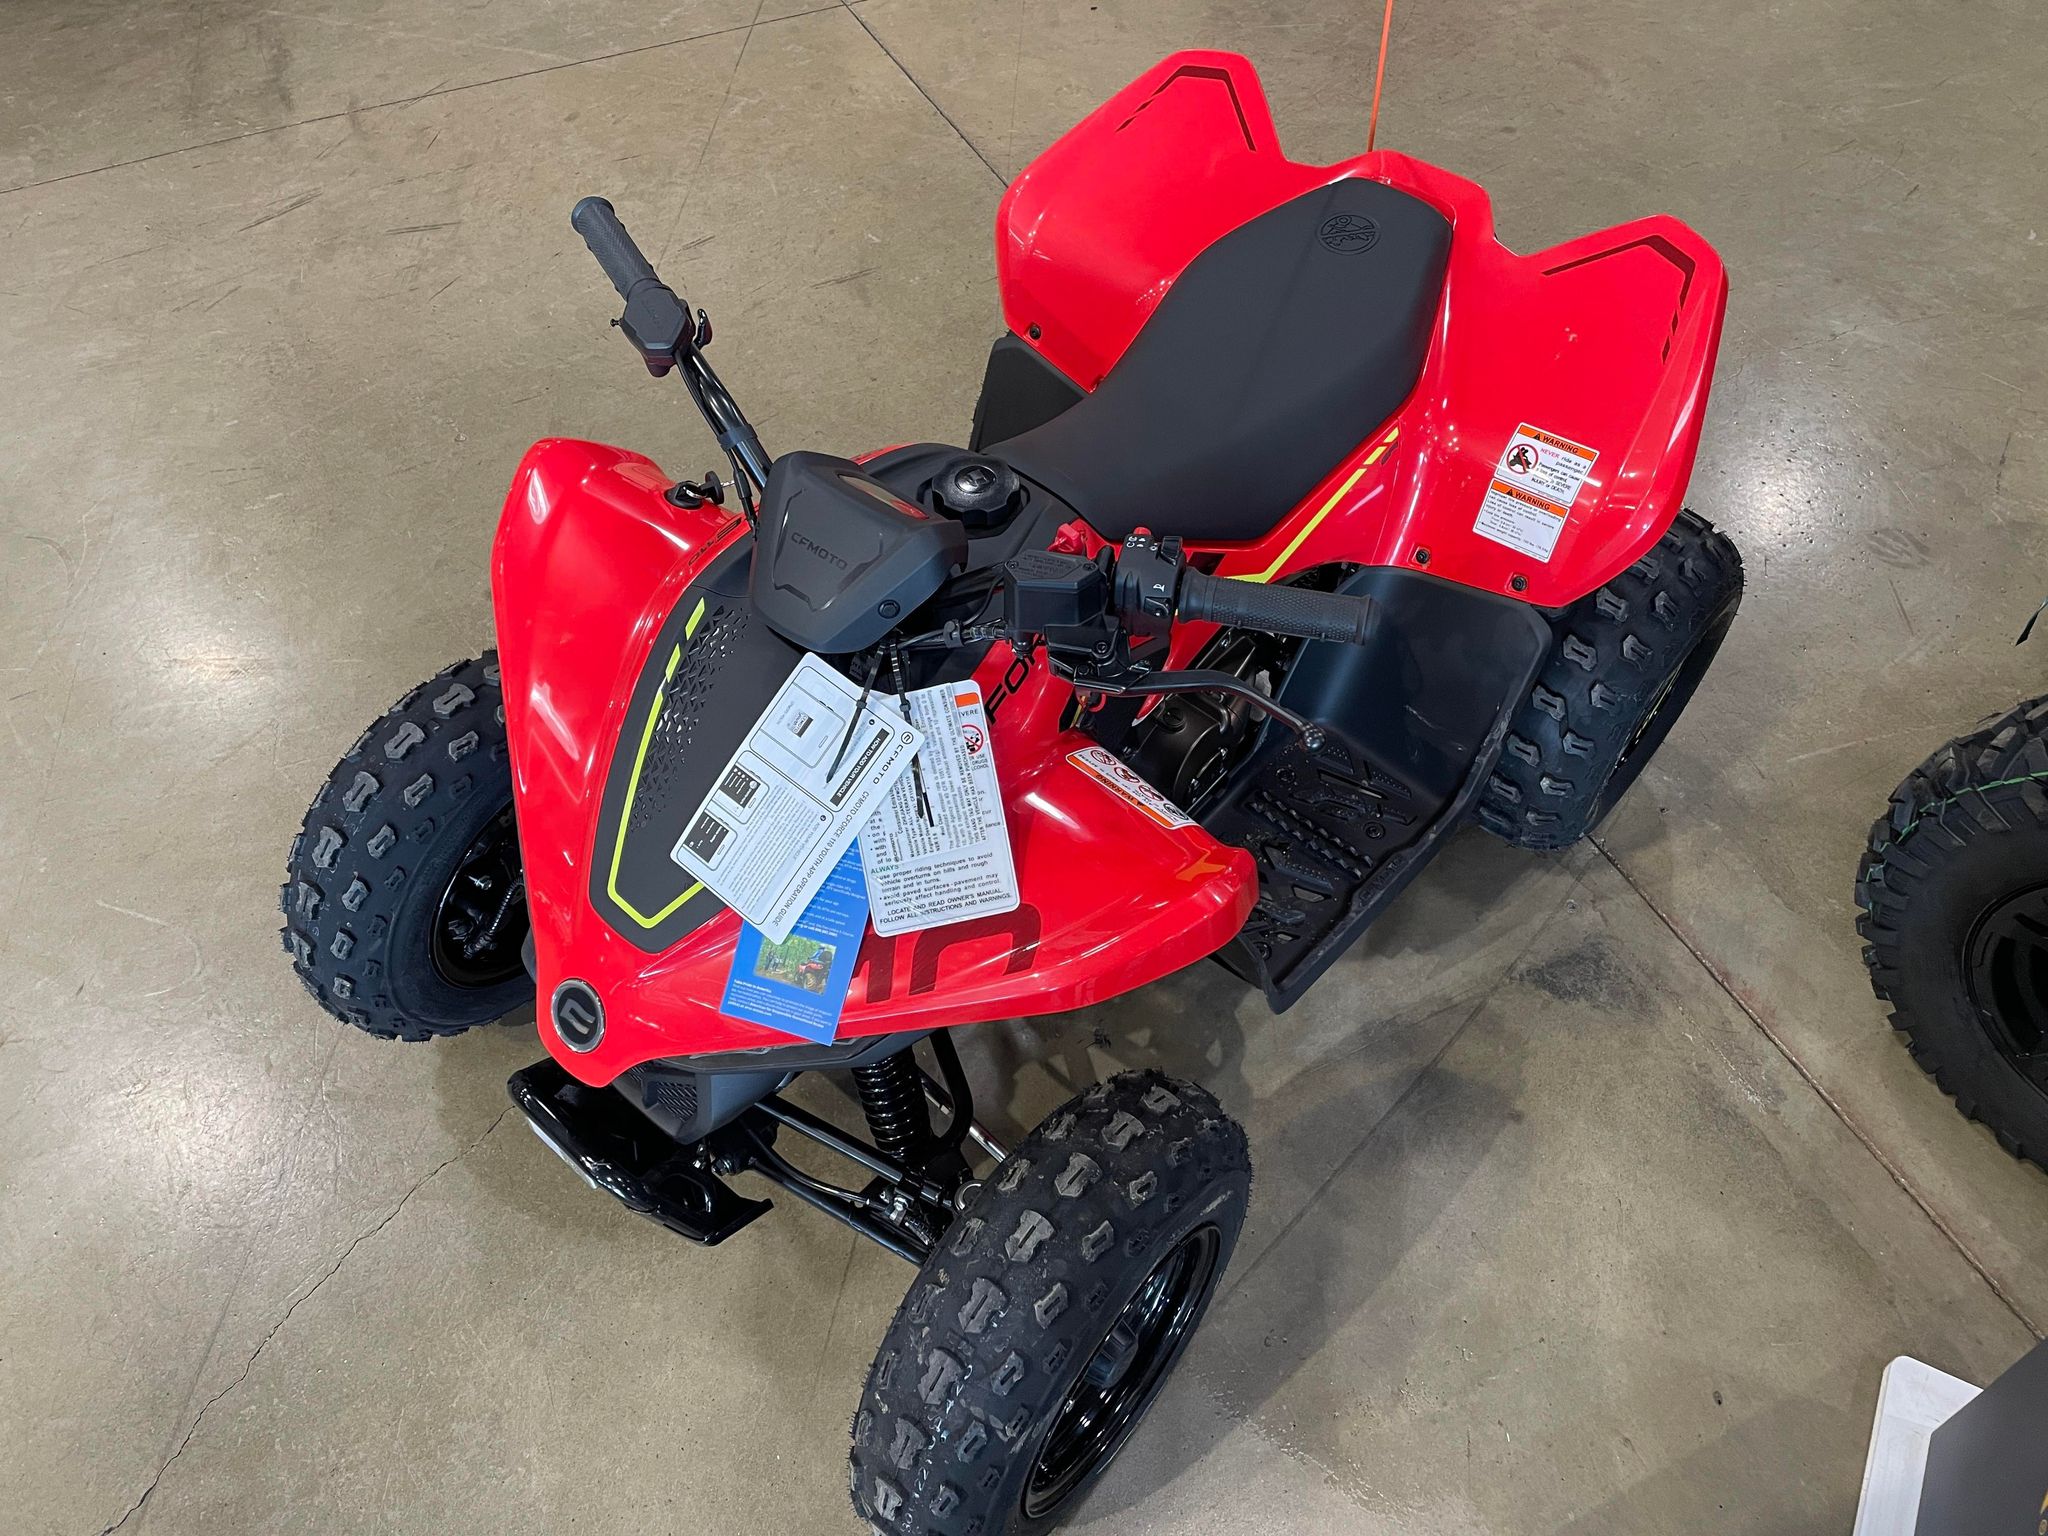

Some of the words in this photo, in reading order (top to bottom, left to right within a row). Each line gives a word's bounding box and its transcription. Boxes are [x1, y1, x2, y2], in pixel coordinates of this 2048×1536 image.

[1540, 448, 1560, 459] NEVER
[1543, 435, 1579, 455] WARNING
[1515, 491, 1551, 511] WARNING
[791, 531, 848, 571] CFMOTO
[870, 737, 881, 750] HOW
[858, 755, 868, 766] ADD
[872, 744, 904, 785] CFMOTO
[955, 754, 965, 776] REMOVED
[960, 744, 971, 772] PURCHASED
[849, 765, 861, 779] YOUR
[836, 778, 853, 798] VEHICLE
[850, 791, 870, 816] CFMOTO
[972, 797, 981, 815] VEHICLE
[833, 814, 853, 839] CFORCE
[826, 837, 836, 848] 110
[813, 846, 830, 867] YOUTH
[805, 865, 817, 879] APP
[871, 864, 899, 875] ALWAYS
[893, 869, 912, 878] proper
[914, 864, 932, 874] riding
[934, 858, 966, 869] techniques
[903, 872, 931, 882] overturns
[971, 860, 989, 869] rough
[924, 877, 941, 885] turns.
[783, 877, 809, 909] OPERATION
[887, 907, 910, 916] LOCATE
[928, 900, 945, 908] READ
[947, 893, 975, 904] OWNER'S
[977, 887, 1003, 898] MANUAL.
[902, 889, 922, 897] paved
[935, 886, 962, 897] handling
[771, 908, 787, 927] GUIDE
[880, 915, 905, 925] FOLLOW
[964, 899, 977, 907] AND
[979, 892, 1012, 904] WARNINGS.
